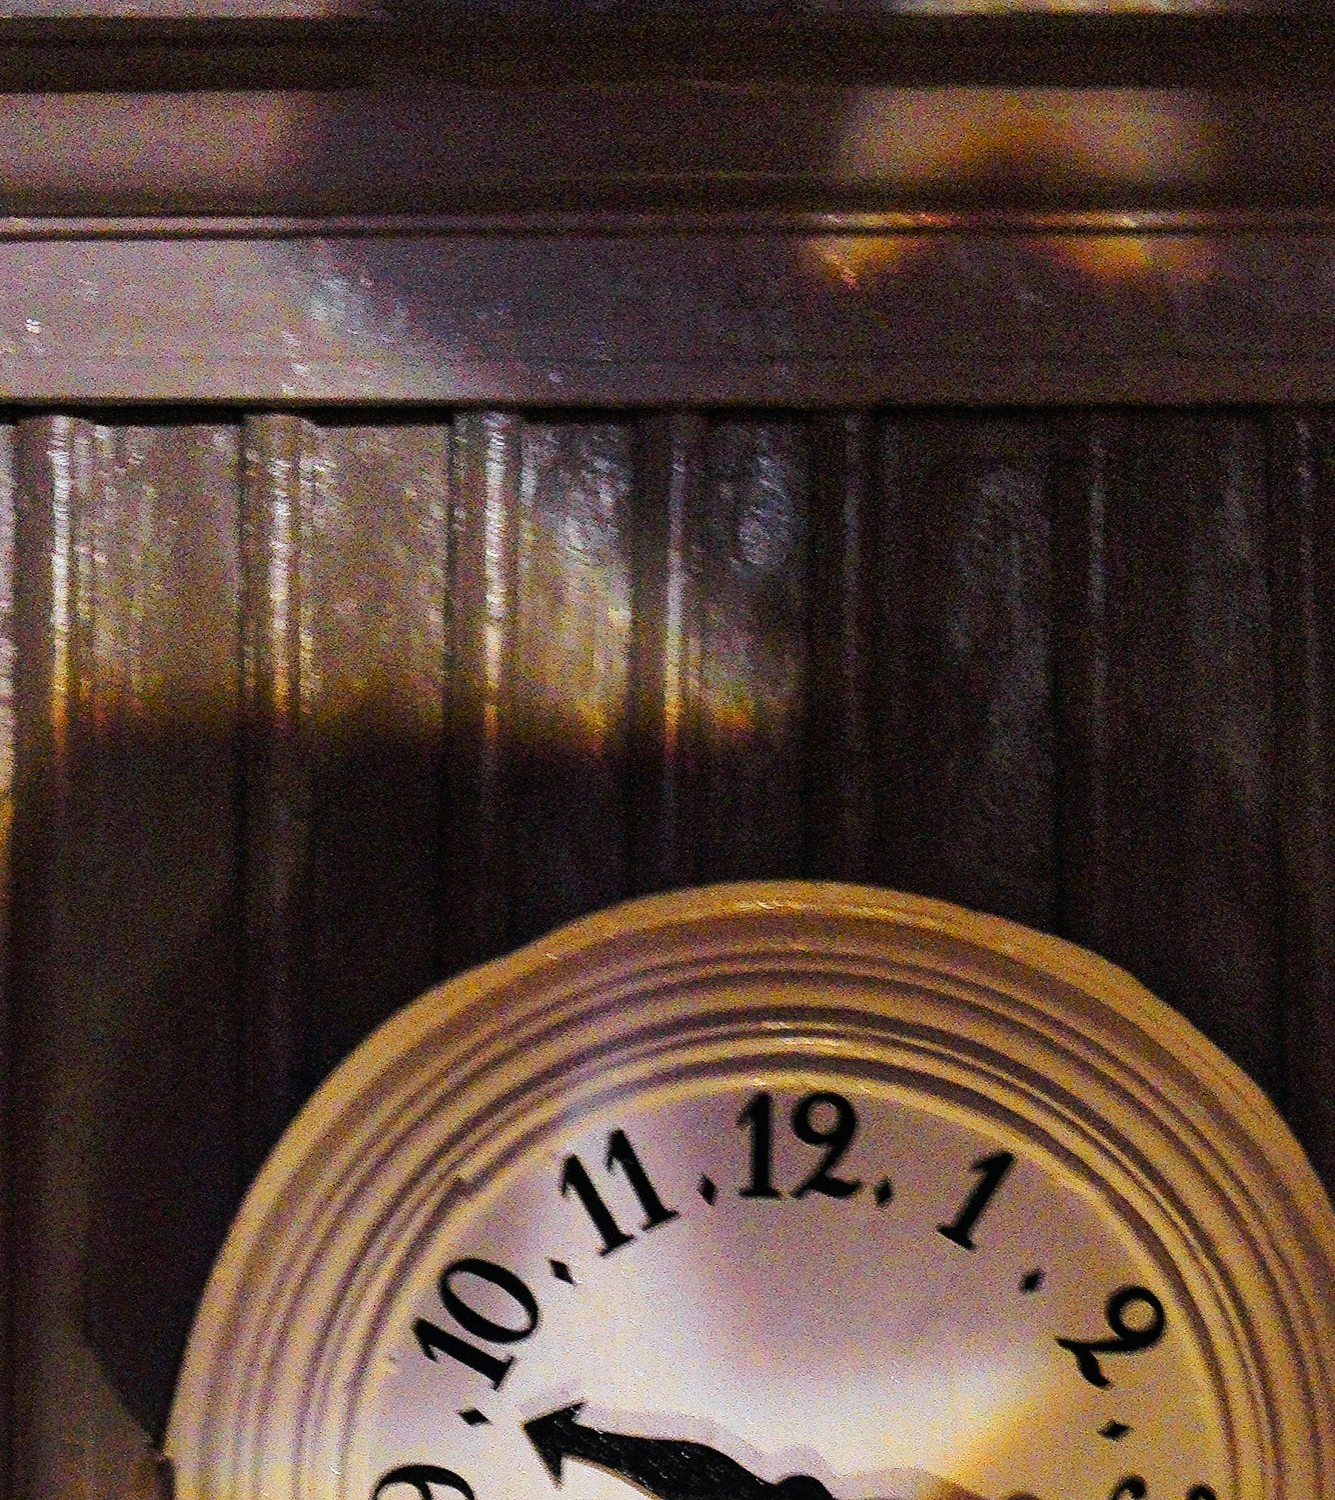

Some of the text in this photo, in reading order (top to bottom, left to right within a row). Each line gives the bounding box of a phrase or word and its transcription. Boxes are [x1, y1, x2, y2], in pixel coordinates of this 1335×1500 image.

[561, 1130, 678, 1256] 11
[736, 1090, 864, 1200] 12
[937, 1149, 1018, 1251] 1
[411, 1257, 540, 1391] 10
[1055, 1284, 1168, 1390] 2
